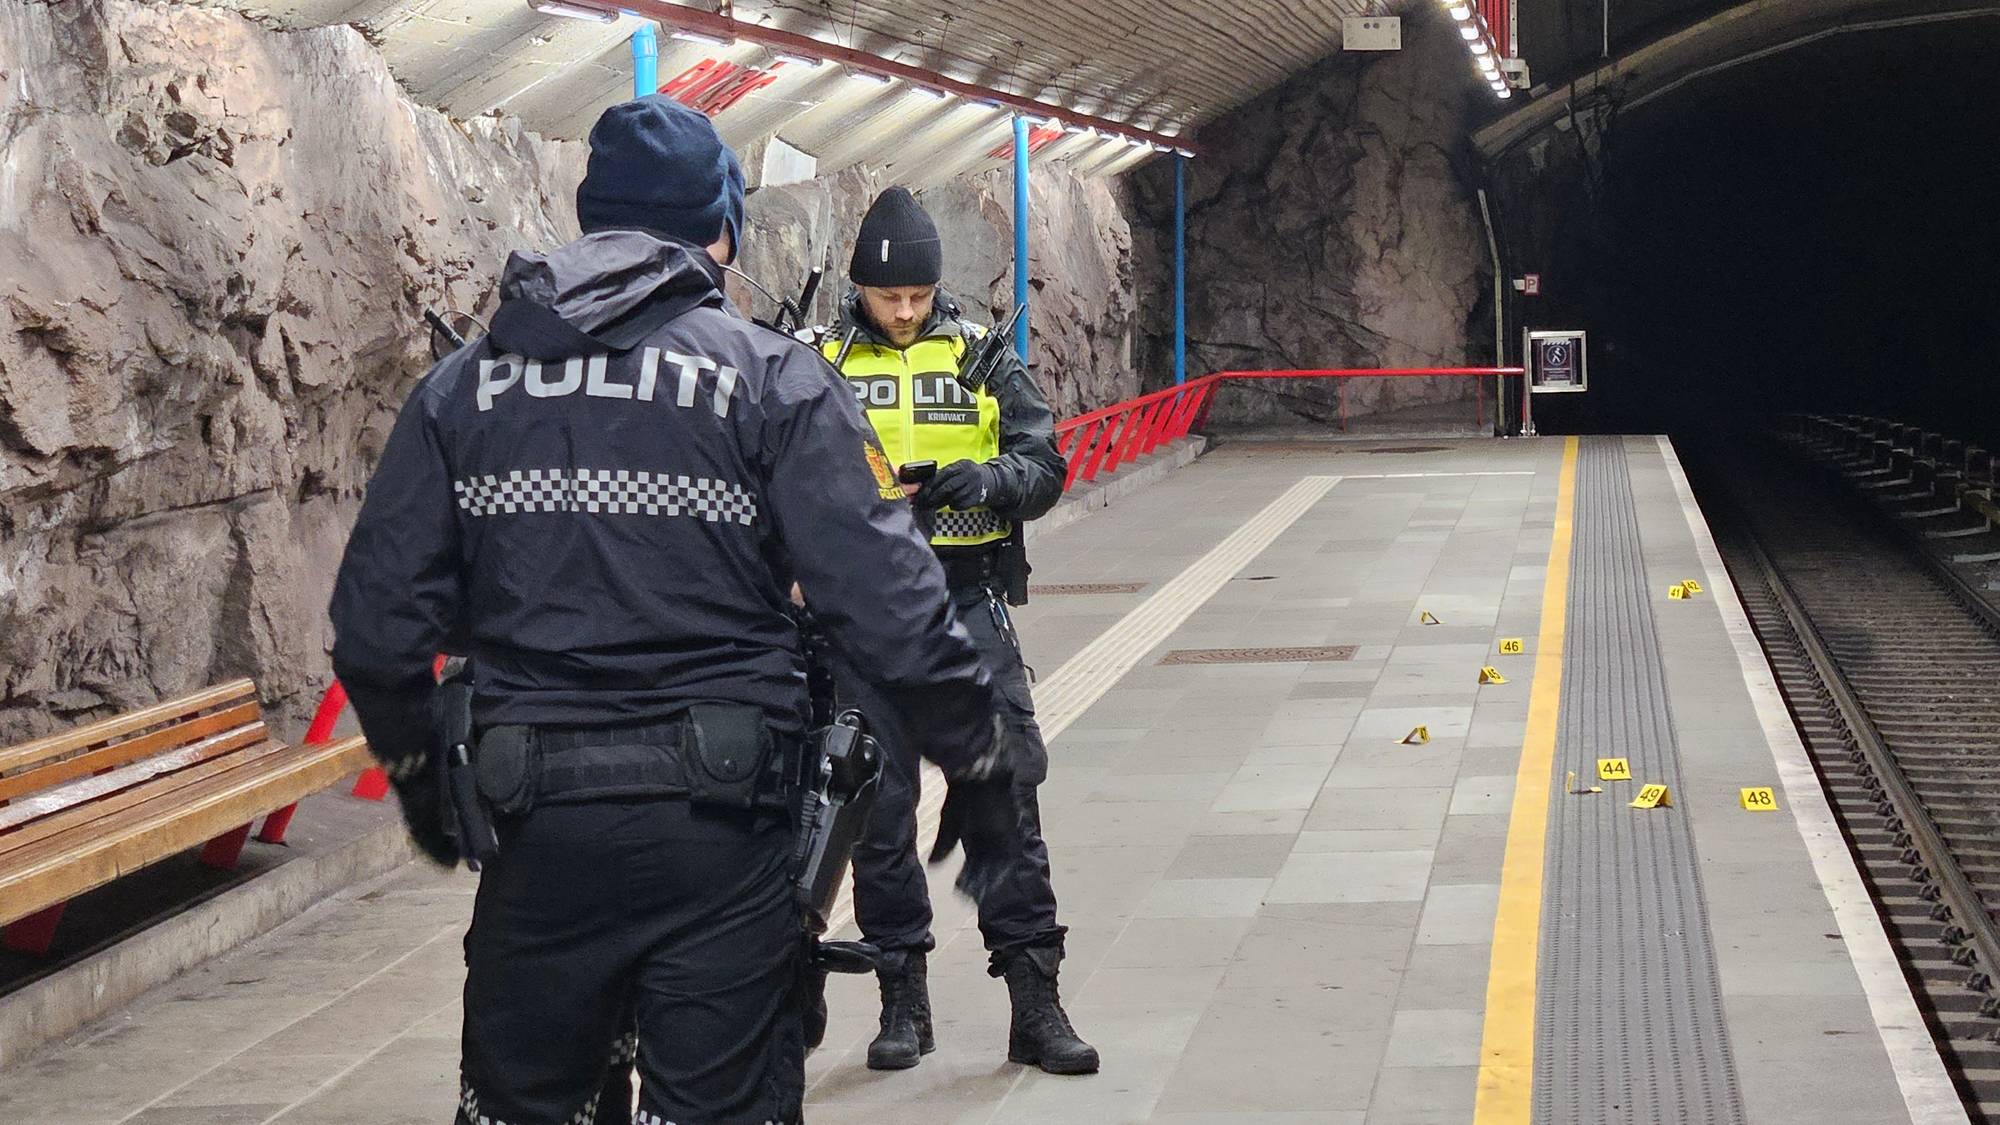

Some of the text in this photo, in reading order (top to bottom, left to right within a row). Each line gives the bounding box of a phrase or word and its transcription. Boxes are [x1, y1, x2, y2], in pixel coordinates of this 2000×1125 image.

[1527, 278, 1537, 290] P
[476, 346, 739, 419] POLITI
[927, 412, 967, 423] KRIMVAKT
[1503, 640, 1519, 652] 46
[1602, 761, 1626, 775] 44
[1639, 787, 1661, 802] 49
[1747, 790, 1771, 805] 48
